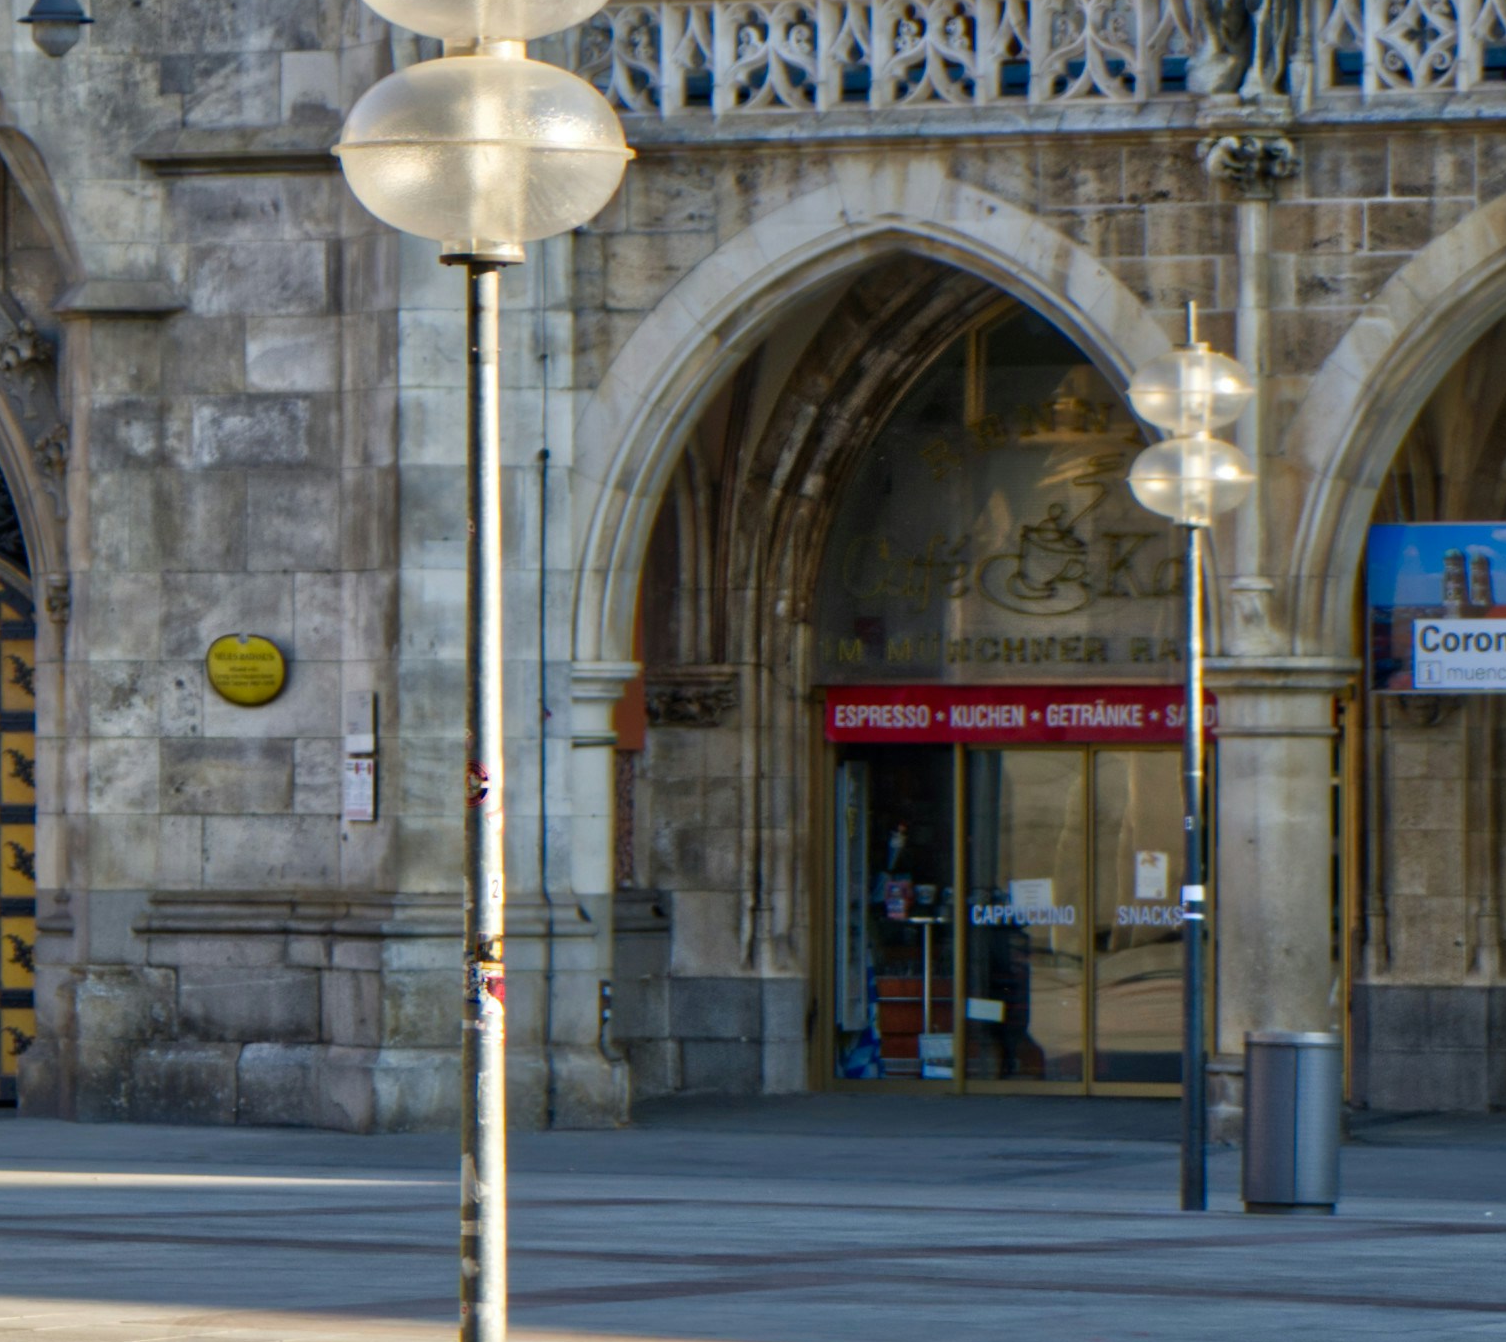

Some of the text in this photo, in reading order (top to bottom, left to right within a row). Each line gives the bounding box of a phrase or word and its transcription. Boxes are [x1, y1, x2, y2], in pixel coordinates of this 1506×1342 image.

[889, 634, 1107, 663] MÜNCHNER
[834, 704, 931, 728] ESPRESSO
[950, 704, 1025, 728] KUCHEN
[1045, 698, 1144, 728] GETRÄNKE
[971, 904, 1076, 925] CAPPUCCINO
[1116, 905, 1184, 926] SNACKS
